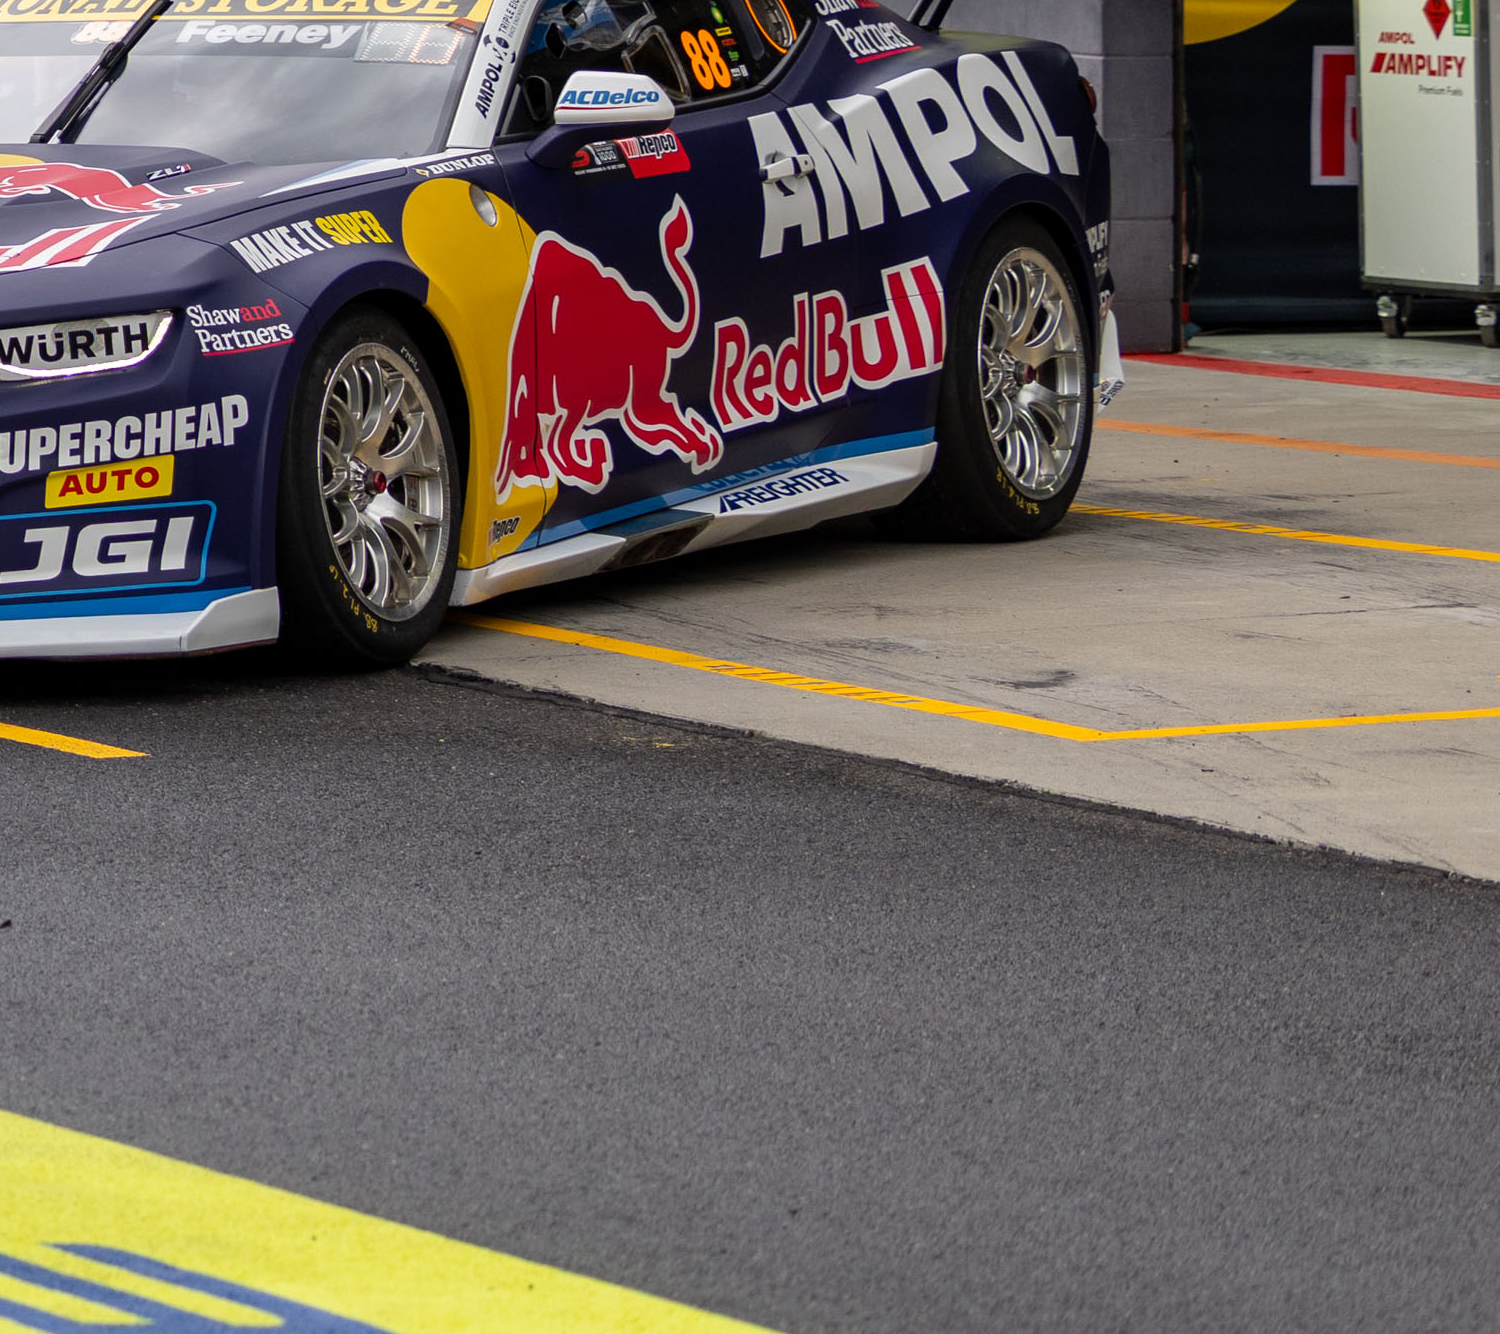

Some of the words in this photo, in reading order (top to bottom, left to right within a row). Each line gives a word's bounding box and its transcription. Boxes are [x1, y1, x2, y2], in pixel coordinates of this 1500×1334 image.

[176, 20, 367, 51] Feeney
[498, 9, 514, 35] TRIPLE
[825, 19, 917, 59] Partners
[1378, 31, 1416, 44] AMPOL
[680, 28, 732, 91] 88
[1380, 52, 1467, 78] AMPLIFY
[475, 55, 504, 120] AMPOL
[560, 88, 660, 105] ACDelco
[639, 132, 678, 160] Repco
[748, 49, 1082, 260] AMPOL
[427, 153, 496, 176] DUNLOP
[300, 220, 332, 254] IT
[314, 209, 393, 247] SUPER
[230, 220, 312, 273] MAKE
[186, 303, 240, 328] Shaw
[240, 298, 281, 323] and
[195, 322, 295, 354] Partners
[711, 292, 815, 432] Red
[813, 257, 947, 407] Bull
[57, 464, 161, 498] AUTO
[722, 467, 848, 513] FREIGHTER
